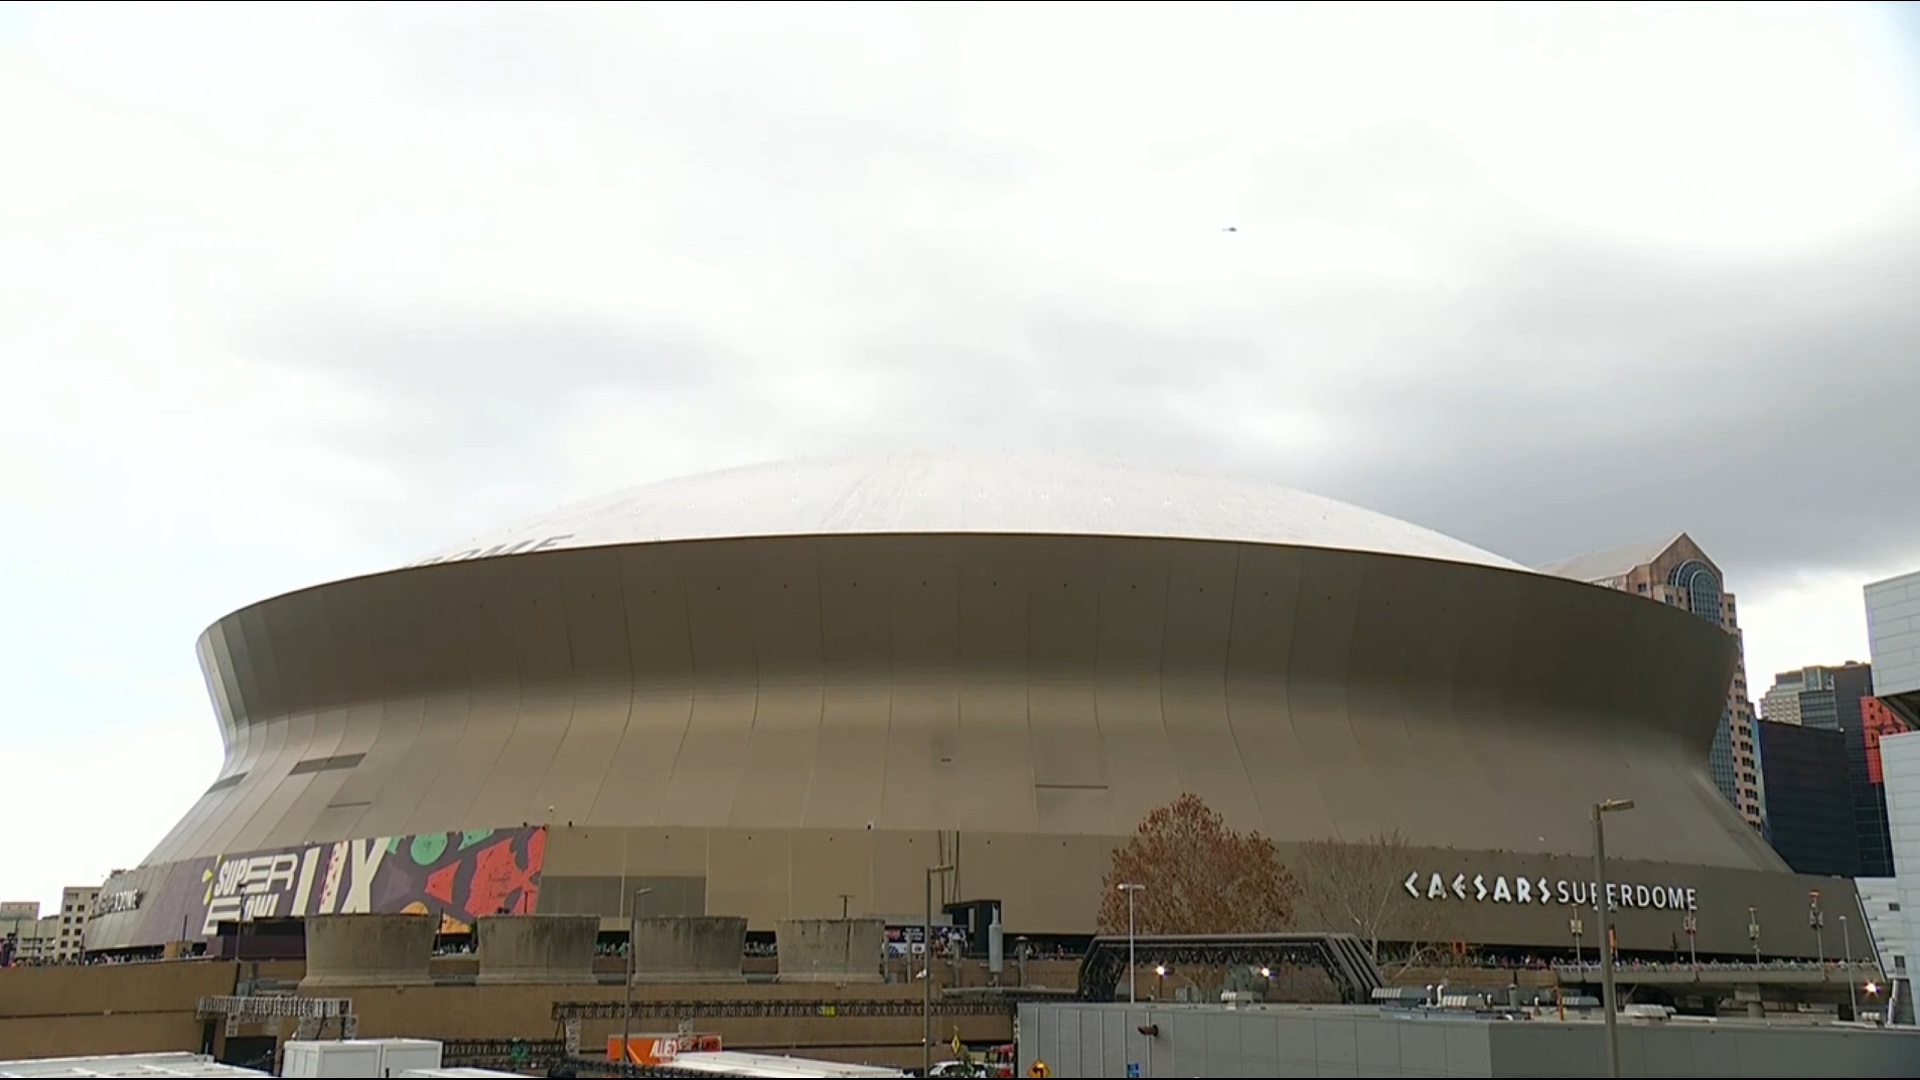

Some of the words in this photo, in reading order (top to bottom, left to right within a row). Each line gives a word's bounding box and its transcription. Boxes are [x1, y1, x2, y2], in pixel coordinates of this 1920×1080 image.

[214, 853, 298, 896] SUPER
[1404, 871, 1550, 904] CAESARS
[1557, 880, 1698, 910] SUPERDOME
